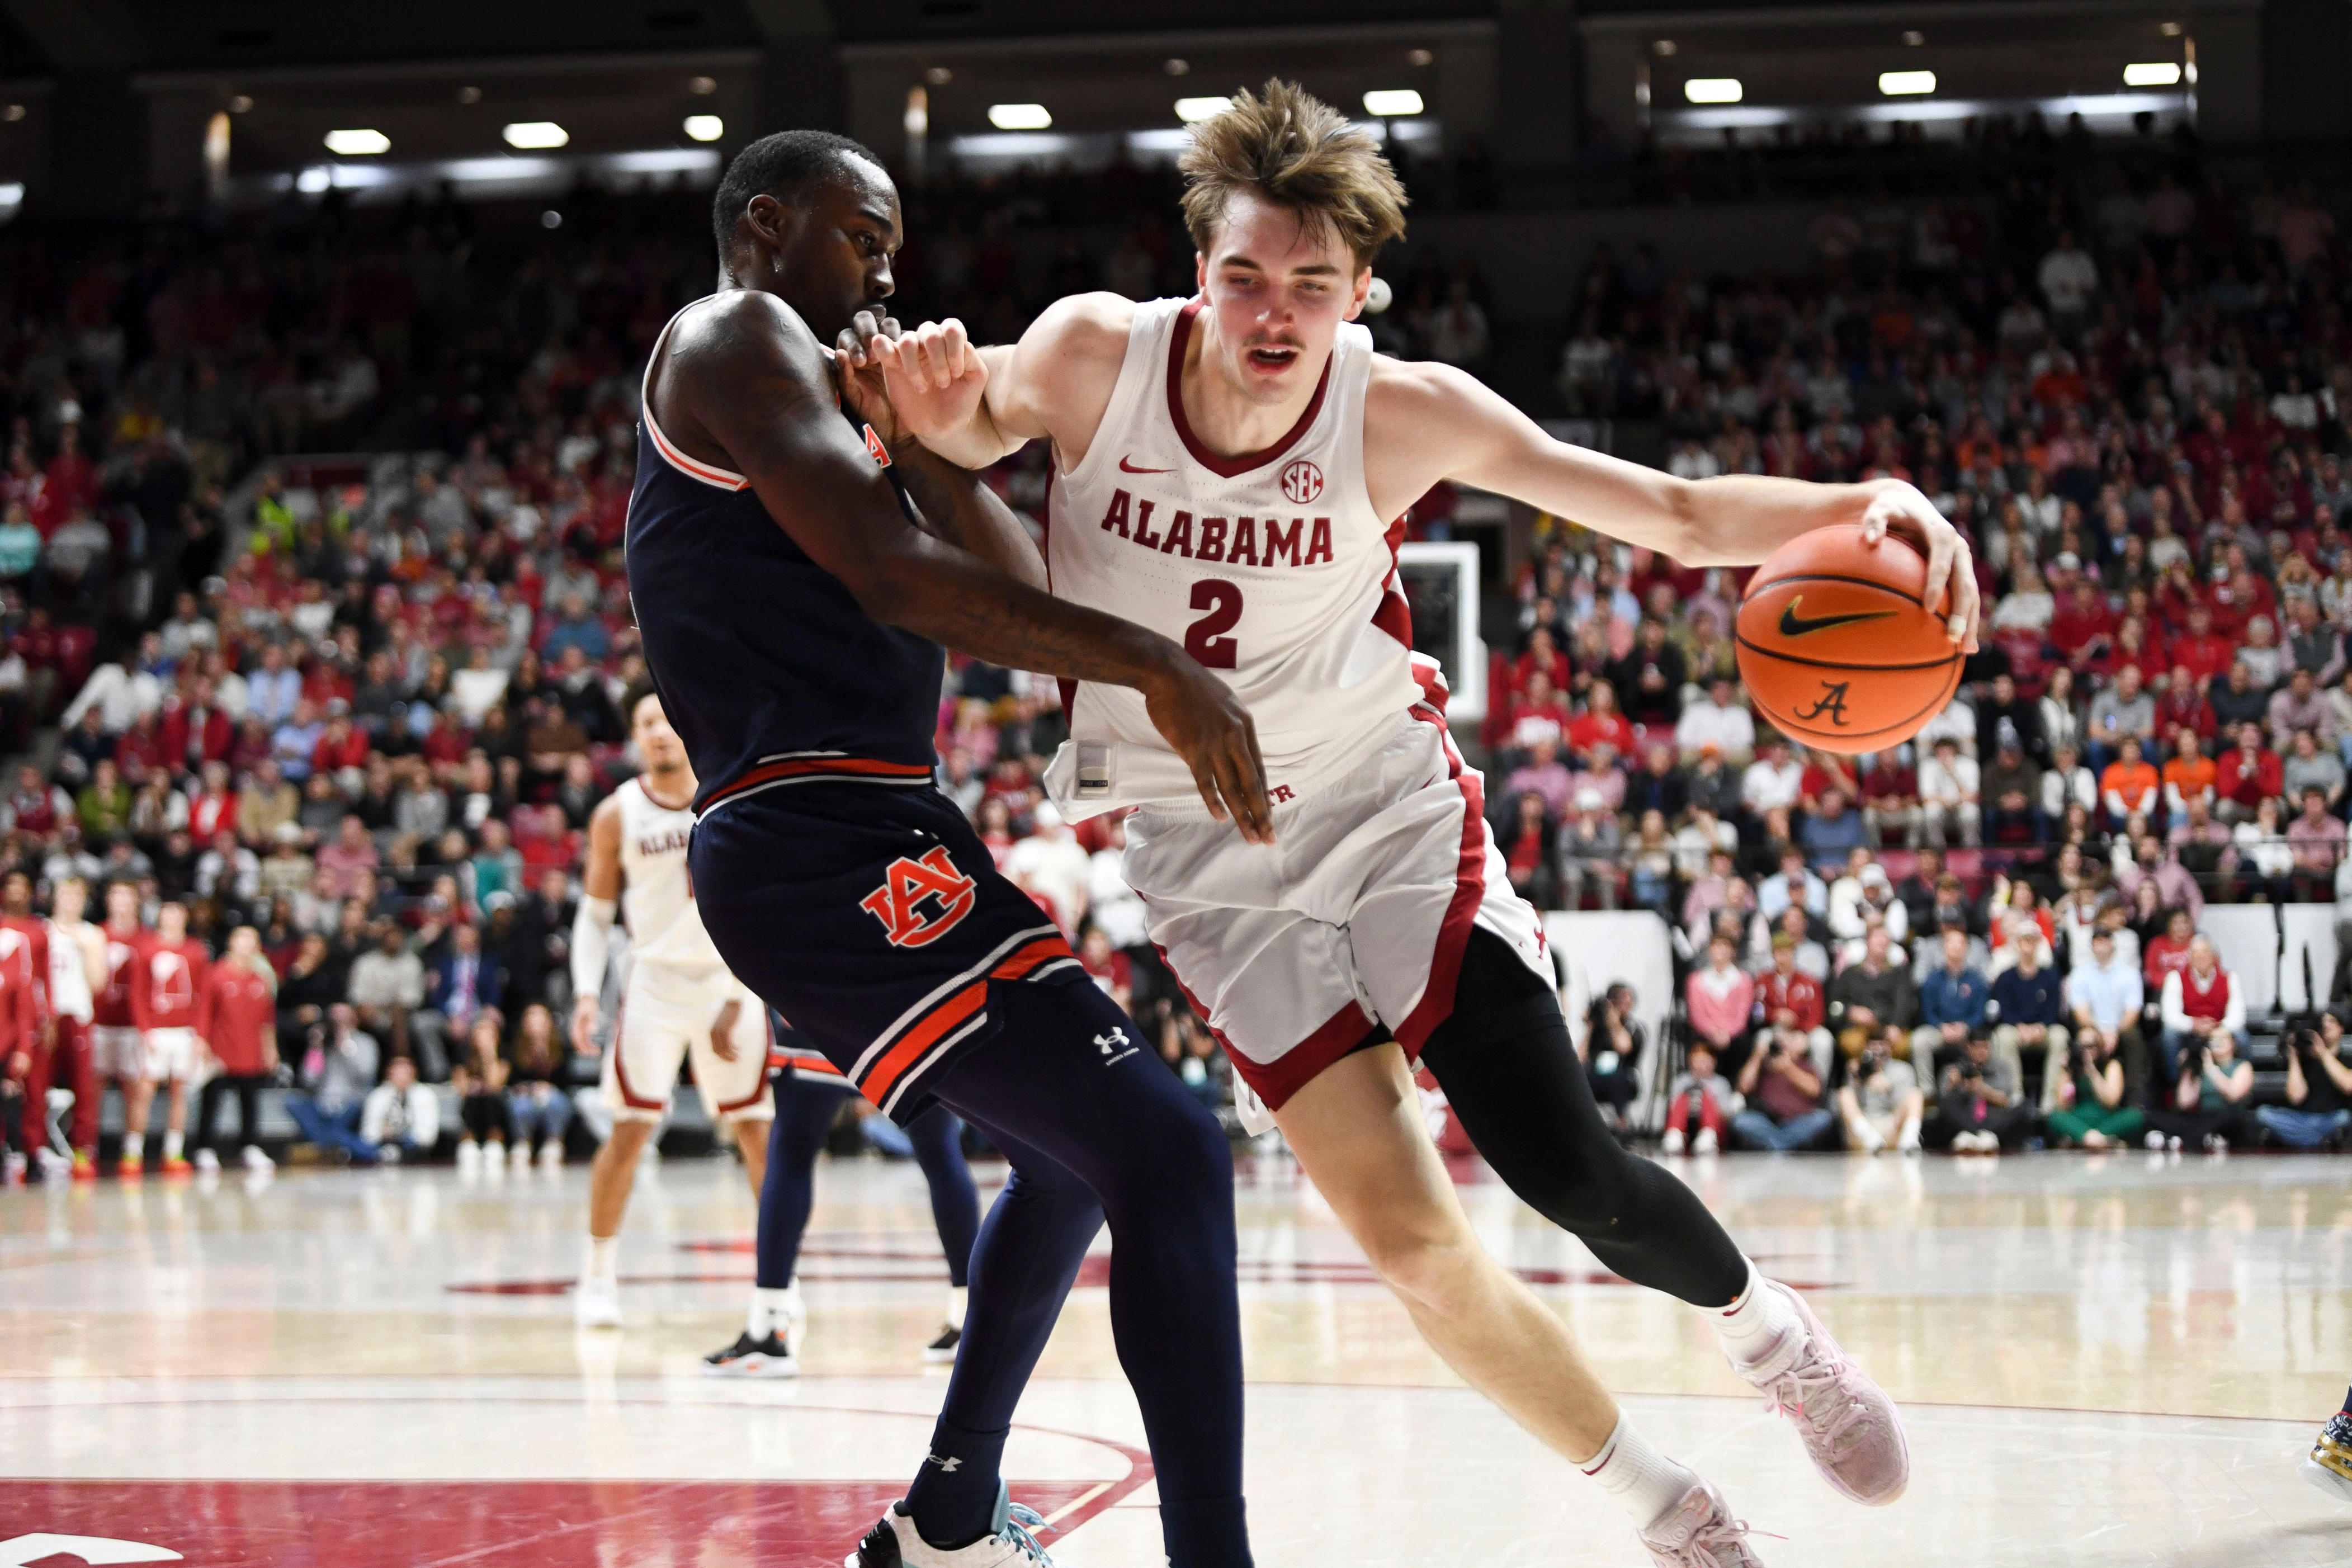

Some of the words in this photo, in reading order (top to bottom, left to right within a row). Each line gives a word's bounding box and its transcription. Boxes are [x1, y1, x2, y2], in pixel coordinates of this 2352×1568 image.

[1284, 464, 1321, 502] SEC
[1101, 488, 1334, 567] ALABAMA
[1184, 578, 1244, 669] 2
